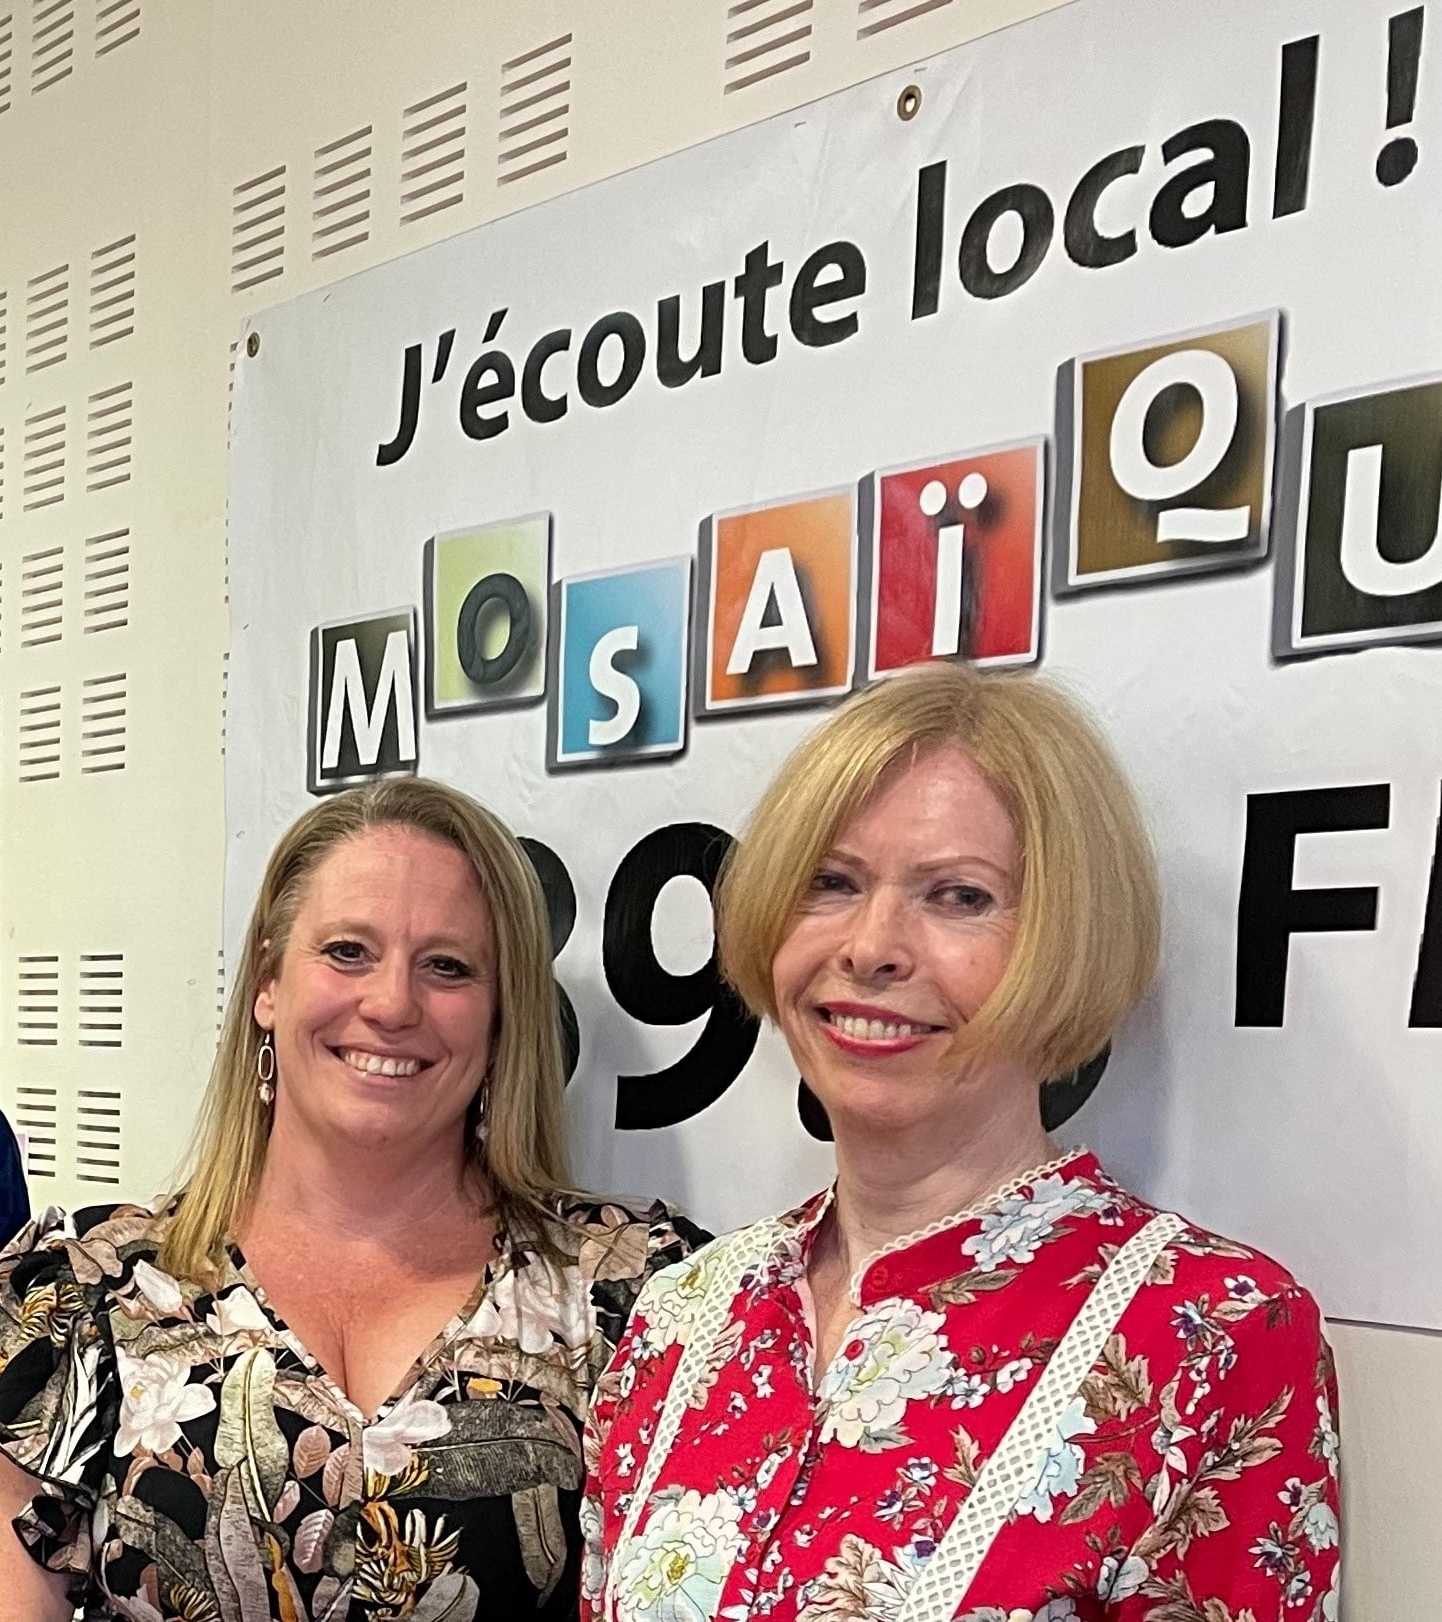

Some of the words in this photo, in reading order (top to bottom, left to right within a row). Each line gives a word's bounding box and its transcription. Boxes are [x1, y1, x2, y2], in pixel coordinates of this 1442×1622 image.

[375, 241, 867, 466] J'écoute
[912, 34, 1322, 321] local
[1374, 5, 1427, 188] !
